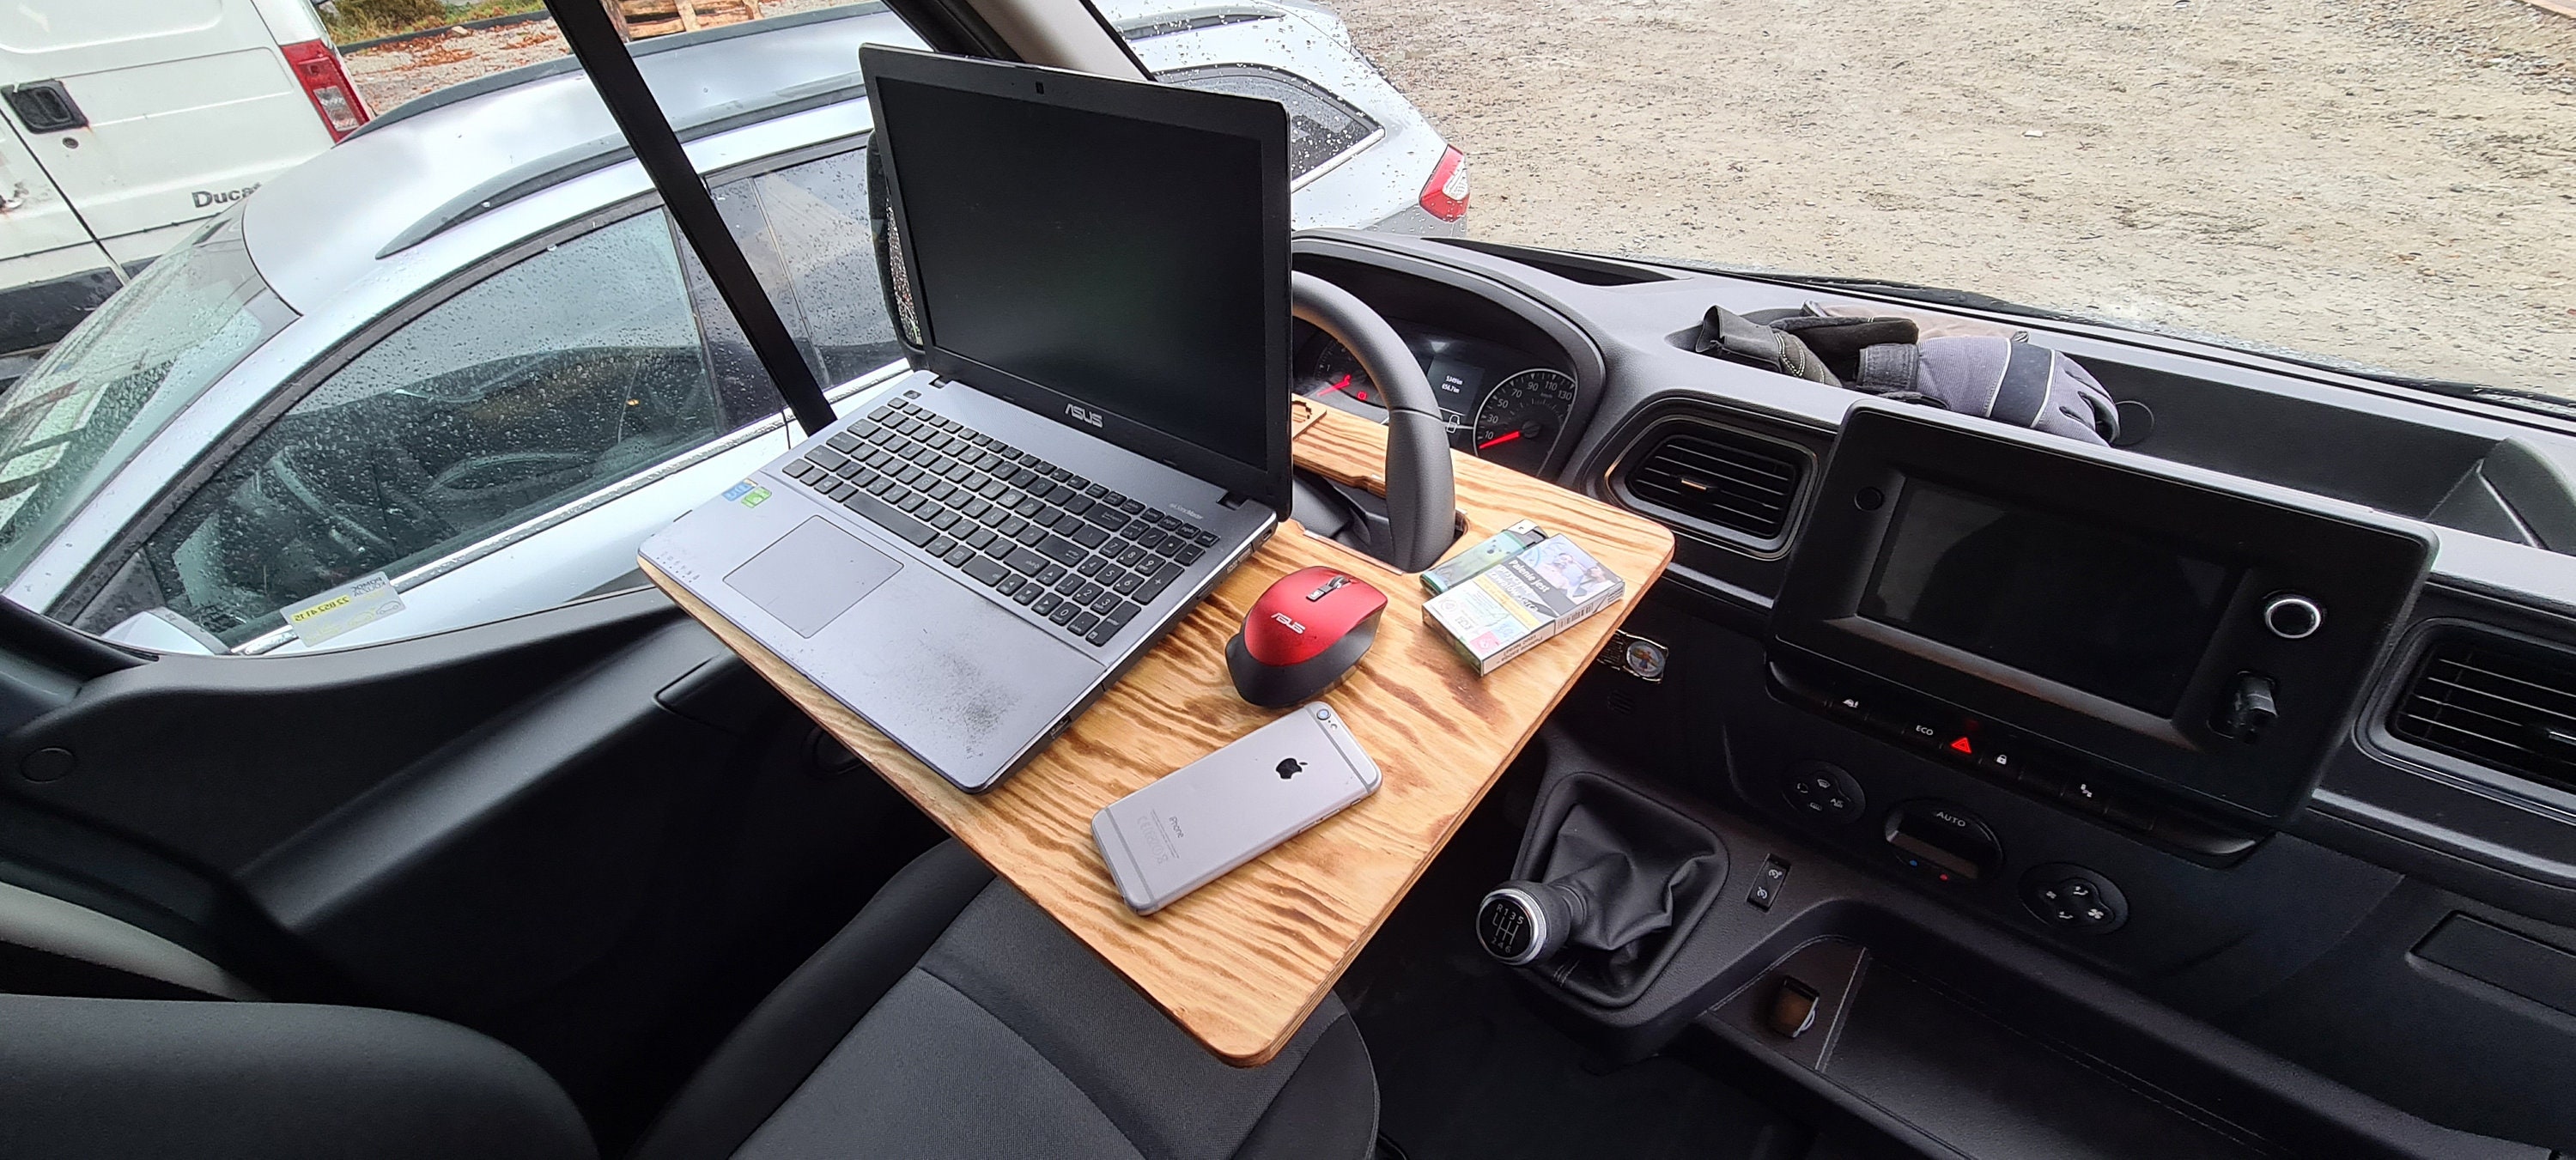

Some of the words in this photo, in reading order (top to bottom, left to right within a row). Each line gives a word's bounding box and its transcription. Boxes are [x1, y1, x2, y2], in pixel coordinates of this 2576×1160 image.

[1528, 381, 1539, 392] 90
[1545, 380, 1558, 392] 110
[1512, 389, 1522, 398] 70
[1558, 390, 1572, 401] 130
[1498, 399, 1509, 409] 50
[1065, 404, 1103, 428] ASUS
[1488, 414, 1498, 423] 30
[1485, 431, 1494, 440] 10
[1508, 559, 1536, 581] Palenie
[1530, 579, 1551, 592] jest
[1271, 612, 1306, 635] ASUS
[1916, 725, 1934, 736] ECO
[1936, 811, 1966, 827] AUTO
[1168, 816, 1185, 838] iPhone
[1496, 903, 1504, 912] R
[1516, 916, 1525, 925] 5
